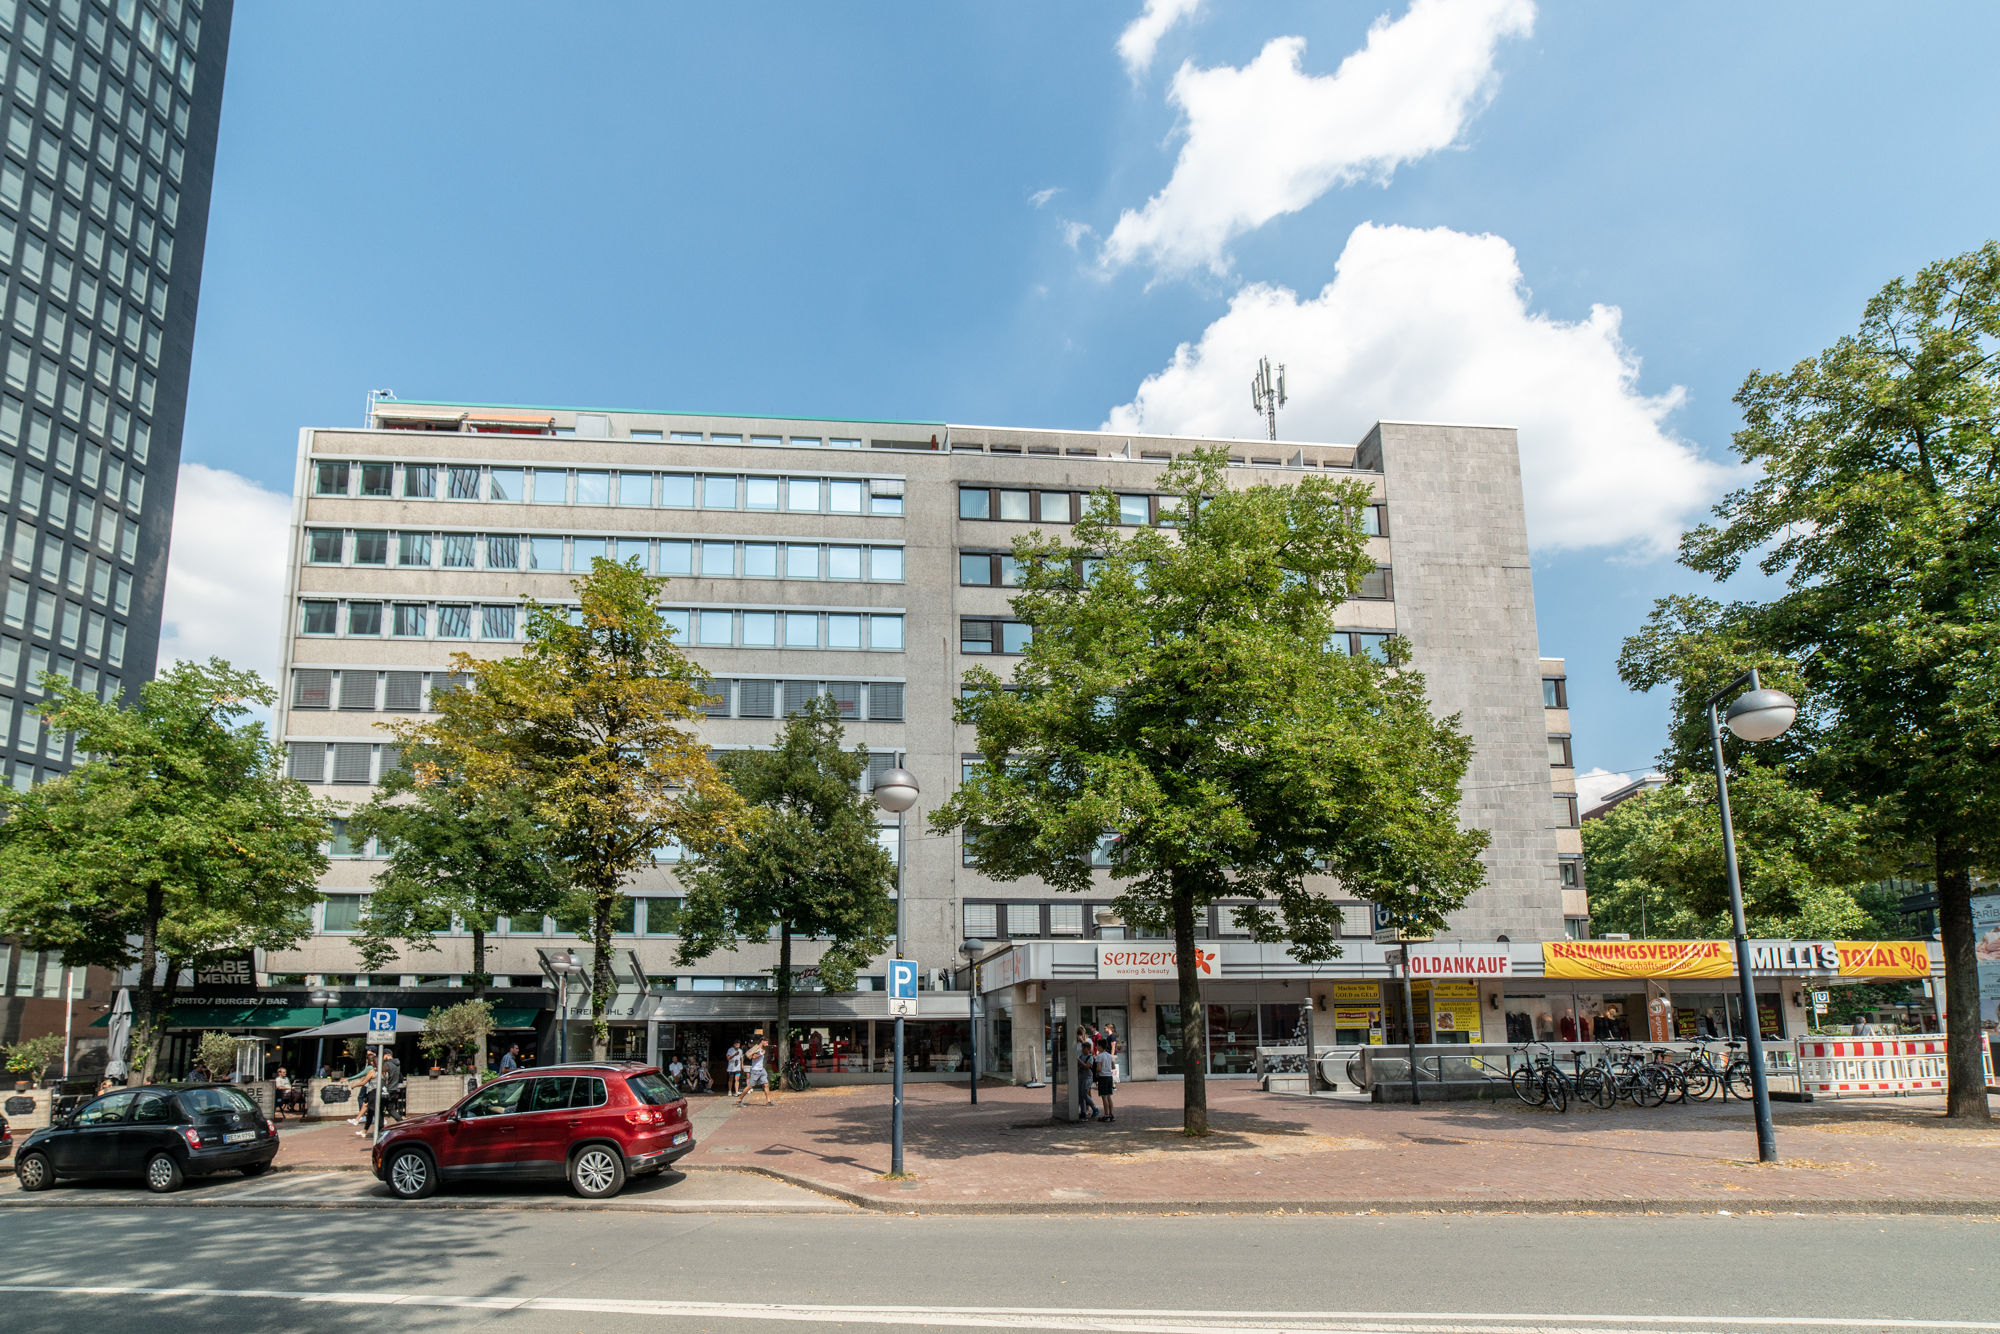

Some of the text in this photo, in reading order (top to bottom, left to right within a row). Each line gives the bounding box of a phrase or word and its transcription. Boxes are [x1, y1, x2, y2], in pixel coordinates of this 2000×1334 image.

[1976, 908, 2000, 918] ARIB
[1552, 941, 1721, 960] RÄUMUNGSVERKAUF
[1750, 944, 1840, 969] MILLI'S
[1839, 946, 1927, 970] TOTAL %
[1587, 961, 1693, 972] wegen Geschäftsaufgabe
[198, 973, 251, 985] MENTE
[895, 966, 912, 997] P
[173, 997, 207, 1005] RRITO
[214, 997, 257, 1005] BURGER
[266, 997, 288, 1005] BAR
[1817, 993, 1826, 1001] U
[570, 1007, 635, 1016] FREIUHL 3
[375, 1011, 391, 1030] P
